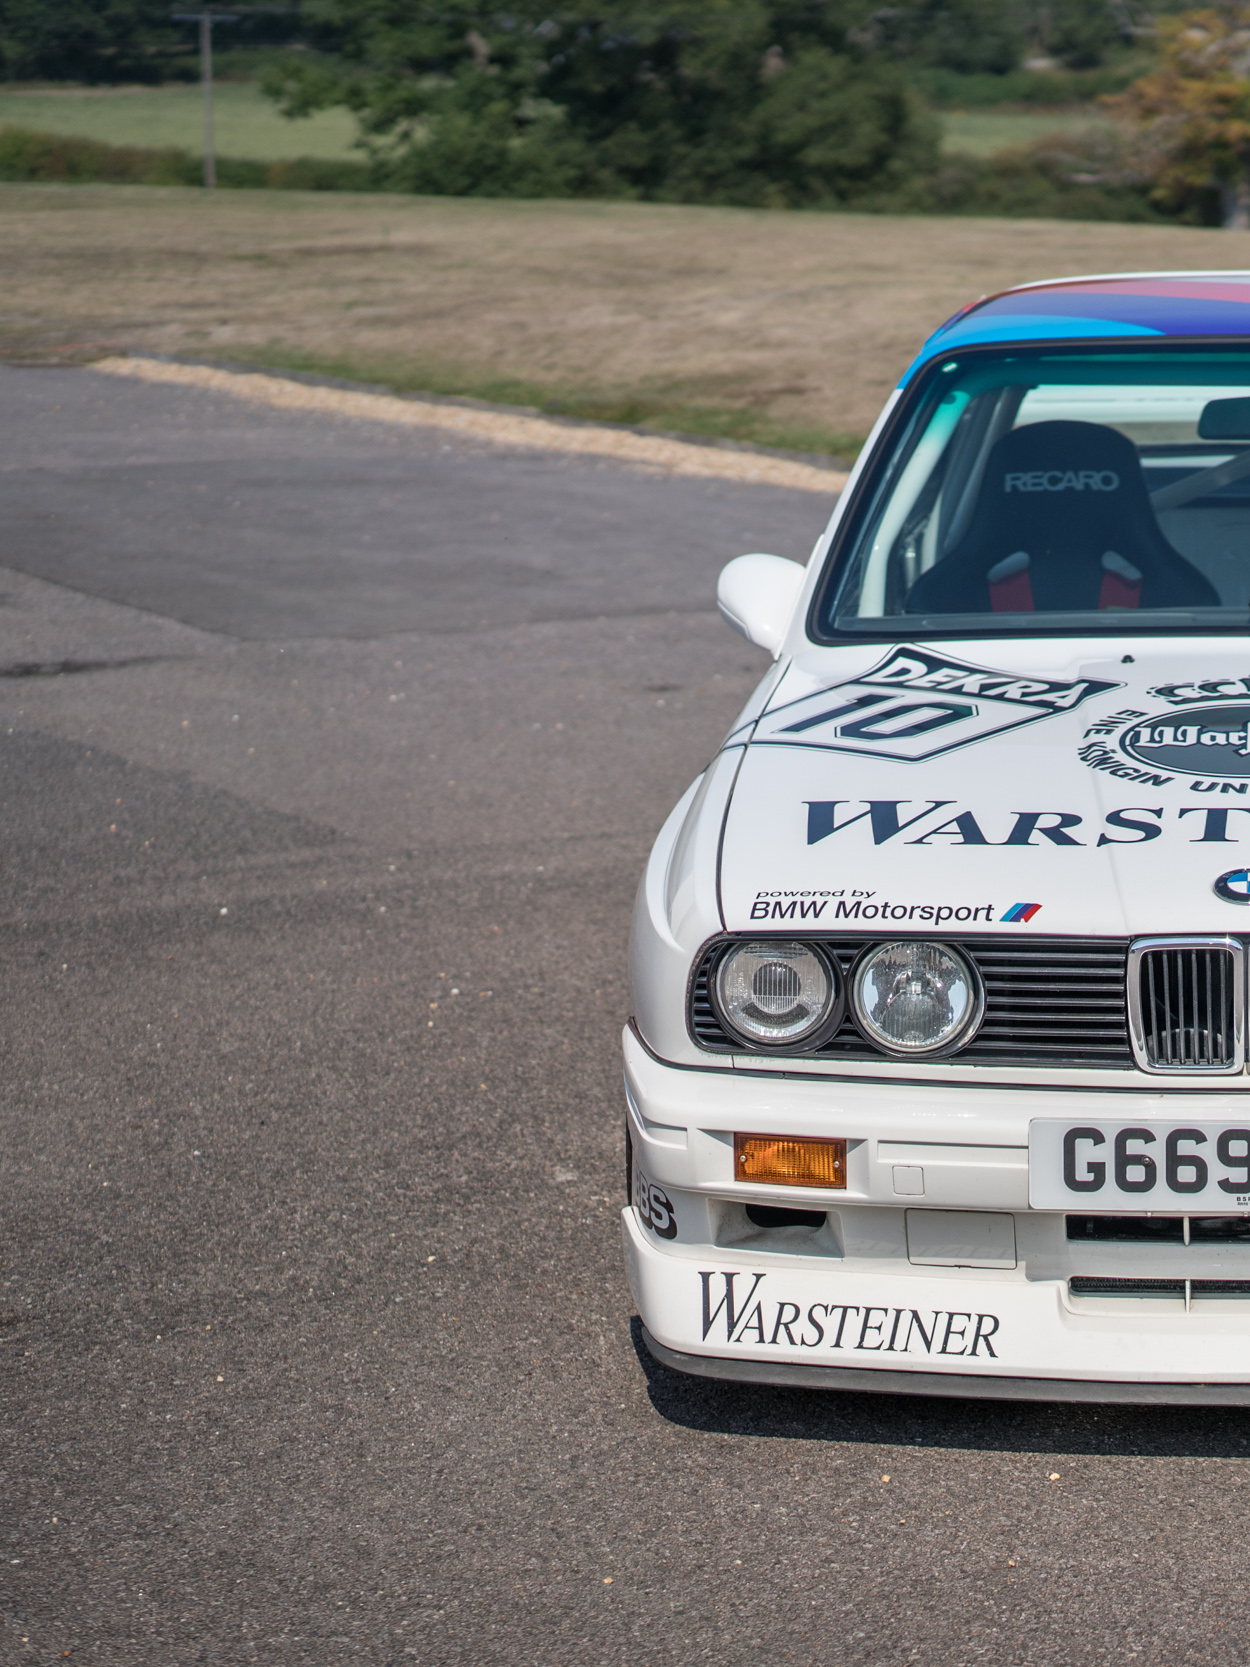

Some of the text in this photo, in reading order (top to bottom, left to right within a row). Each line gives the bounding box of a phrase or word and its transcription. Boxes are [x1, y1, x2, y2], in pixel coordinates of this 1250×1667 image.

[1004, 470, 1120, 493] RECARO
[859, 655, 1090, 708] DEKRA
[770, 692, 980, 742] 10
[1082, 709, 1150, 739] EINE
[1077, 741, 1176, 787] KÖNIGIN
[749, 901, 996, 926] BMW Motorsport
[755, 889, 877, 900] powered by
[697, 1271, 1001, 1358] WARSTEINER
